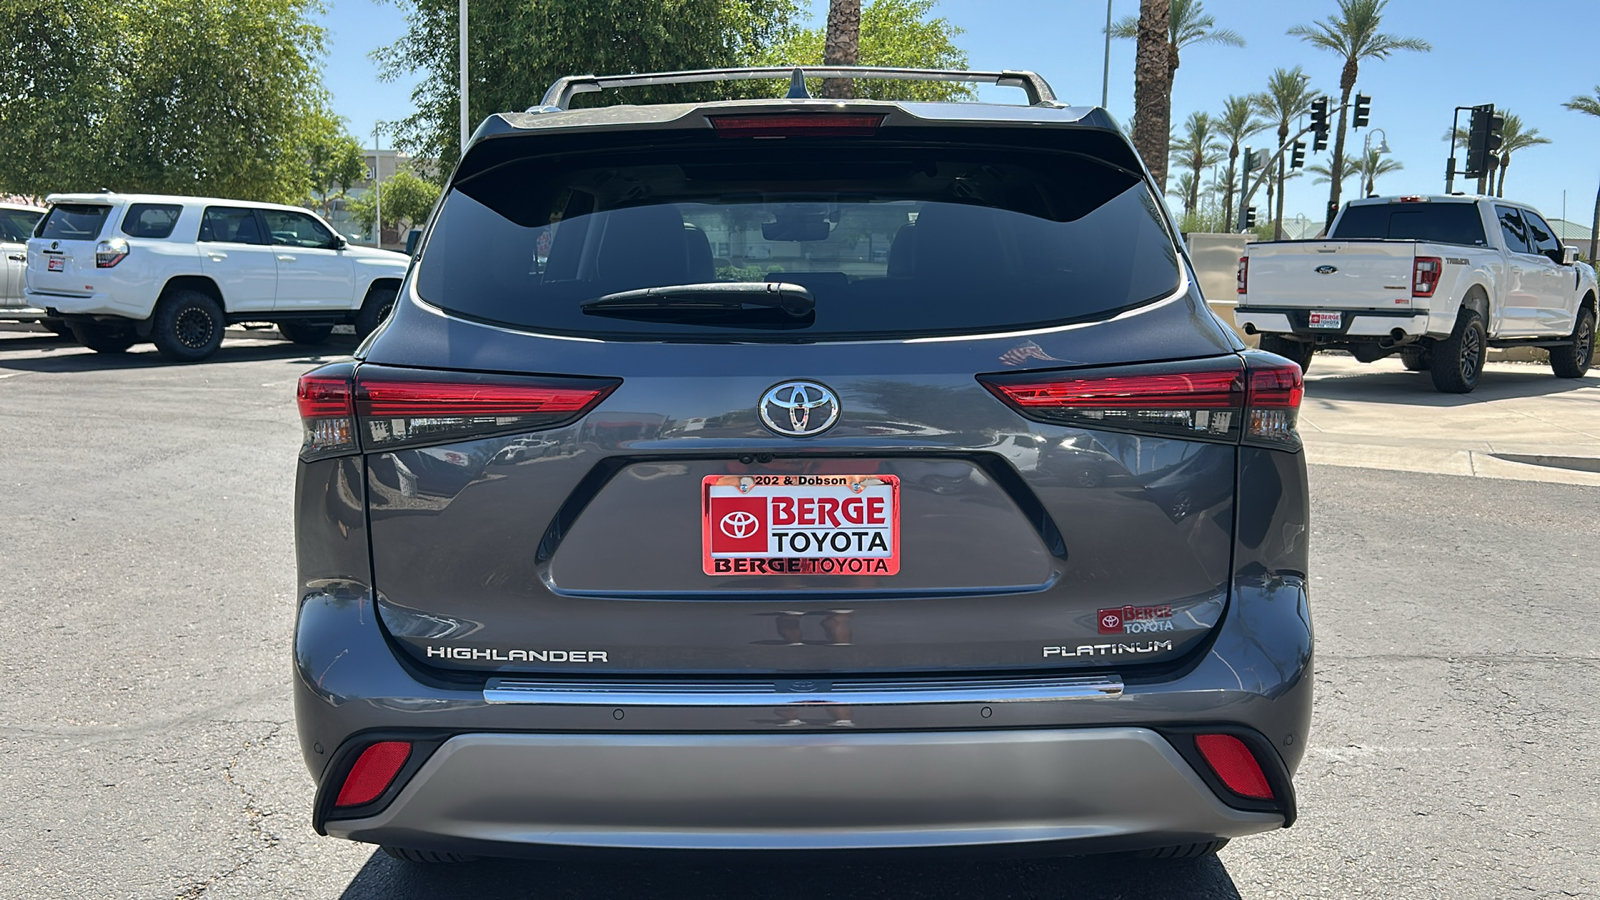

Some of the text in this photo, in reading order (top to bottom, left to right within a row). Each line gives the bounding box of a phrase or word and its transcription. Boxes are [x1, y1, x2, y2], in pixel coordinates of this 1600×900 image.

[756, 476, 847, 485] 202 & Dobson
[771, 496, 886, 529] BERGE
[772, 531, 888, 553] TOYOTA
[714, 558, 888, 573] BERGE TOYOTA
[1123, 604, 1173, 621] BERGE
[1123, 620, 1174, 634] TOYOTA
[426, 646, 609, 663] HIGHLANDER
[1043, 640, 1173, 658] PLATINUM
